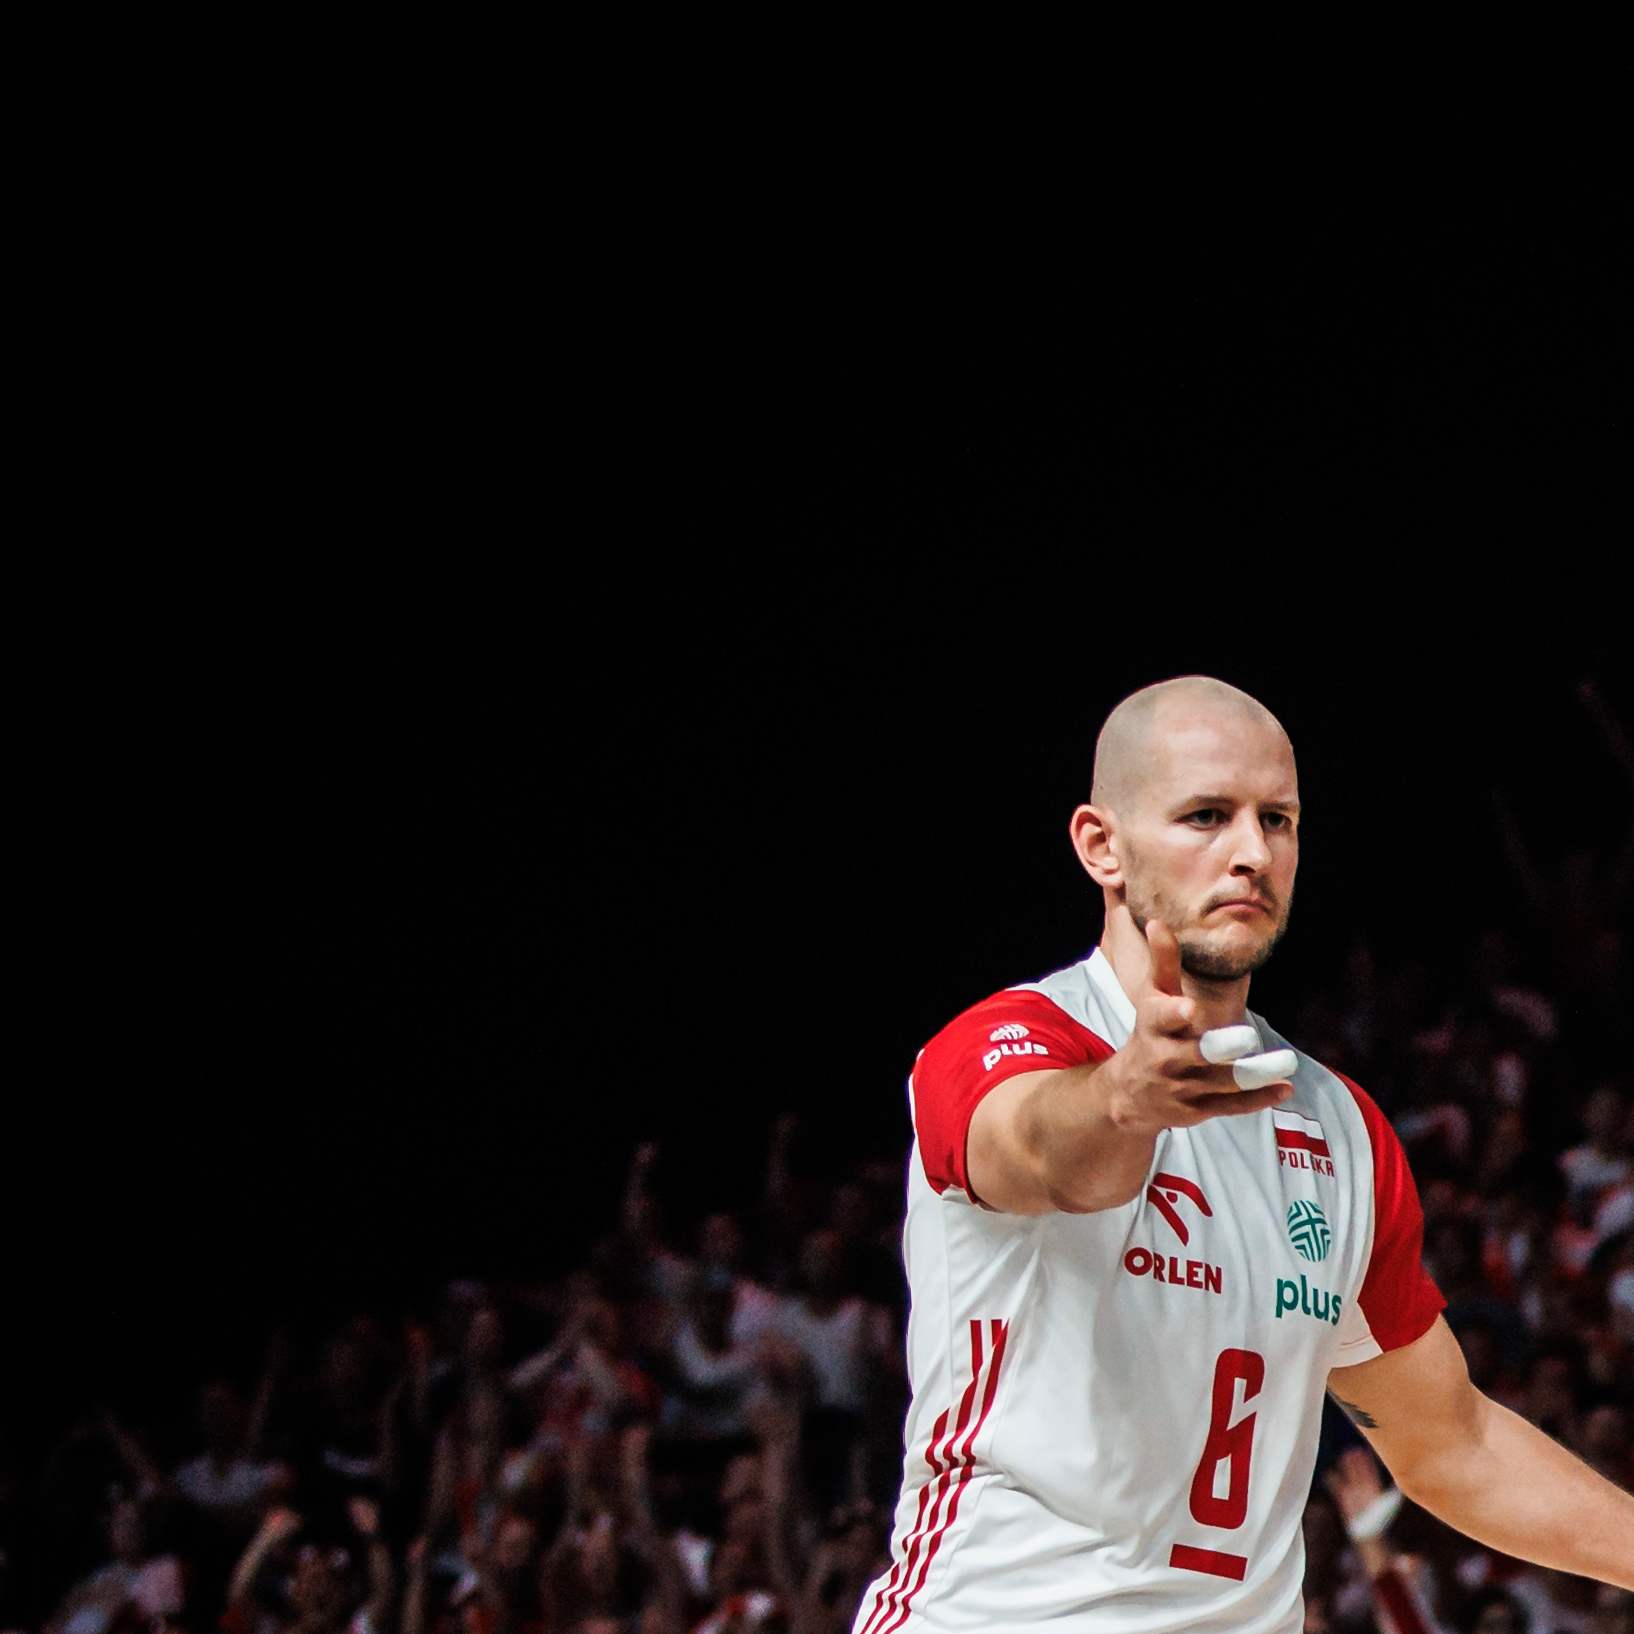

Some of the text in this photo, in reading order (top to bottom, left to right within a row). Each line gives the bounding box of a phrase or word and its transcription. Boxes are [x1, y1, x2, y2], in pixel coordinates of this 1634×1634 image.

[982, 1040, 1049, 1072] plus
[1123, 1247, 1223, 1294] ORLEN
[1274, 1273, 1342, 1327] plus
[1188, 1347, 1266, 1530] 6
